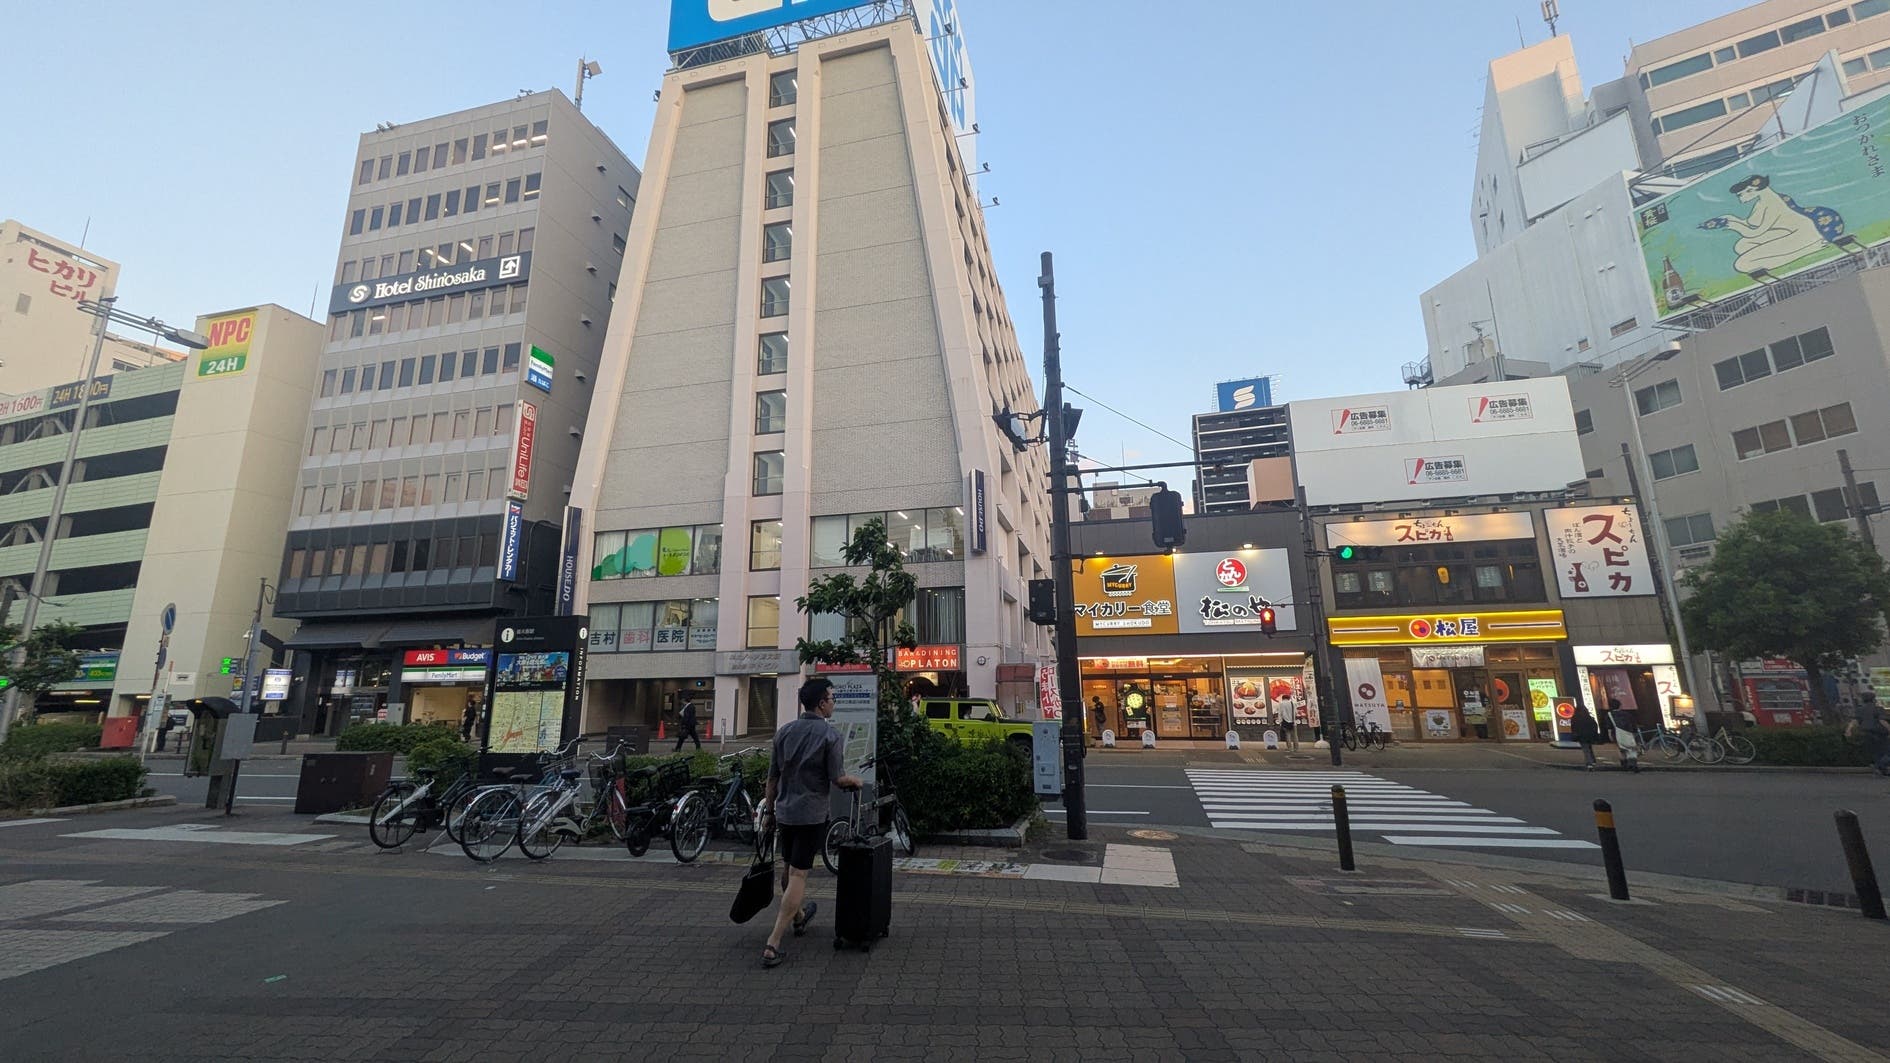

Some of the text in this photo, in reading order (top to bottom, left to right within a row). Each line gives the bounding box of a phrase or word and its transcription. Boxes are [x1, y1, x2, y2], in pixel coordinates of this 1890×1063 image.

[1854, 113, 1886, 178] おつかれさま
[28, 247, 97, 288] ヒカリ
[50, 279, 87, 301] ビル
[374, 277, 412, 300] Hotel
[208, 316, 251, 348] NPC
[206, 356, 238, 375] 24H
[1489, 398, 1528, 408] 広告募集
[1351, 410, 1387, 420] 広告募集
[1425, 460, 1463, 470] 広告募集
[1582, 514, 1632, 592] スピカ
[1218, 558, 1243, 587] とんかつ
[1073, 600, 1172, 618] マイカリー食堂
[1200, 595, 1272, 619] 松のや
[1434, 618, 1480, 637] 松屋
[416, 652, 486, 662] AVIS Budget
[910, 658, 957, 668] PLATON
